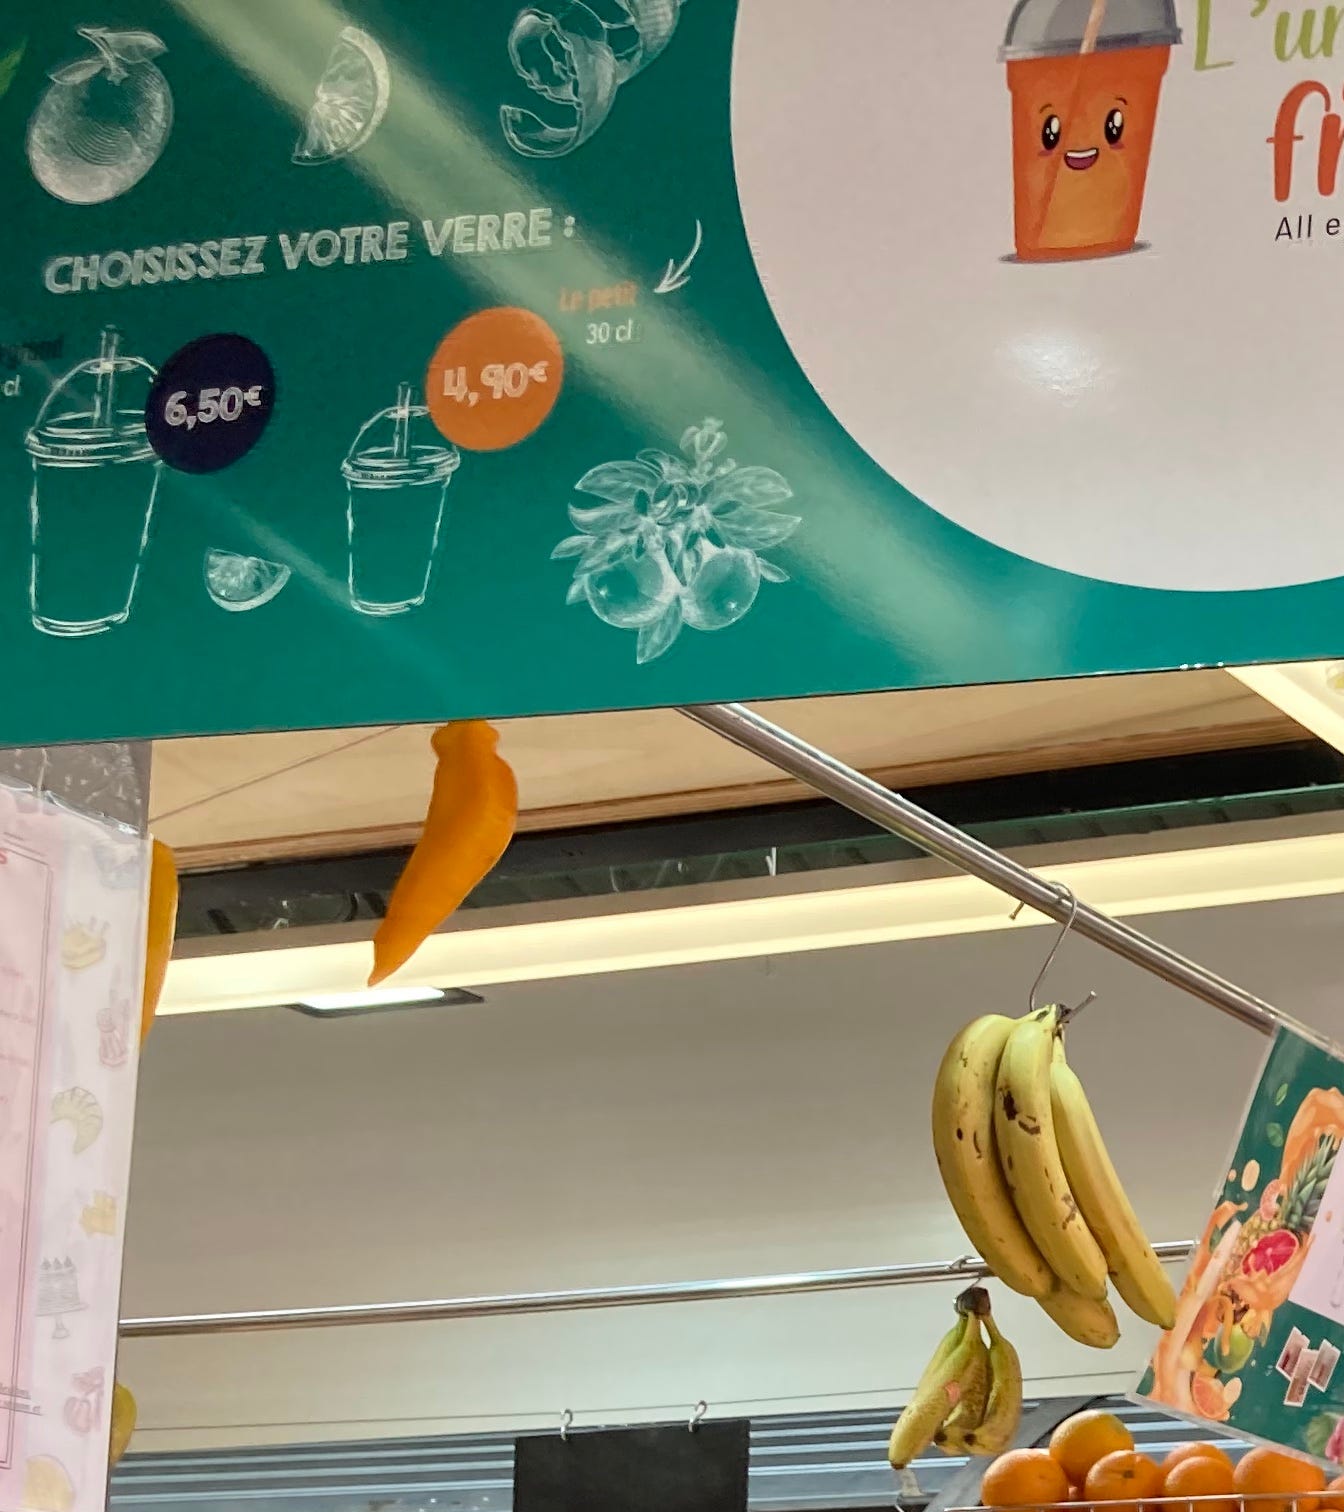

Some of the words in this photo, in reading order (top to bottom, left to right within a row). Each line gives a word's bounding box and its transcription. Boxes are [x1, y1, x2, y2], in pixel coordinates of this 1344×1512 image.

[1274, 213, 1312, 241] All
[44, 235, 267, 295] CHOISISSEZ
[278, 221, 409, 271] VOTRE
[422, 207, 552, 257] VERRE
[585, 321, 610, 344] 30
[615, 317, 633, 342] cl
[442, 360, 551, 408] 4,90€
[164, 385, 264, 431] 6,50€
